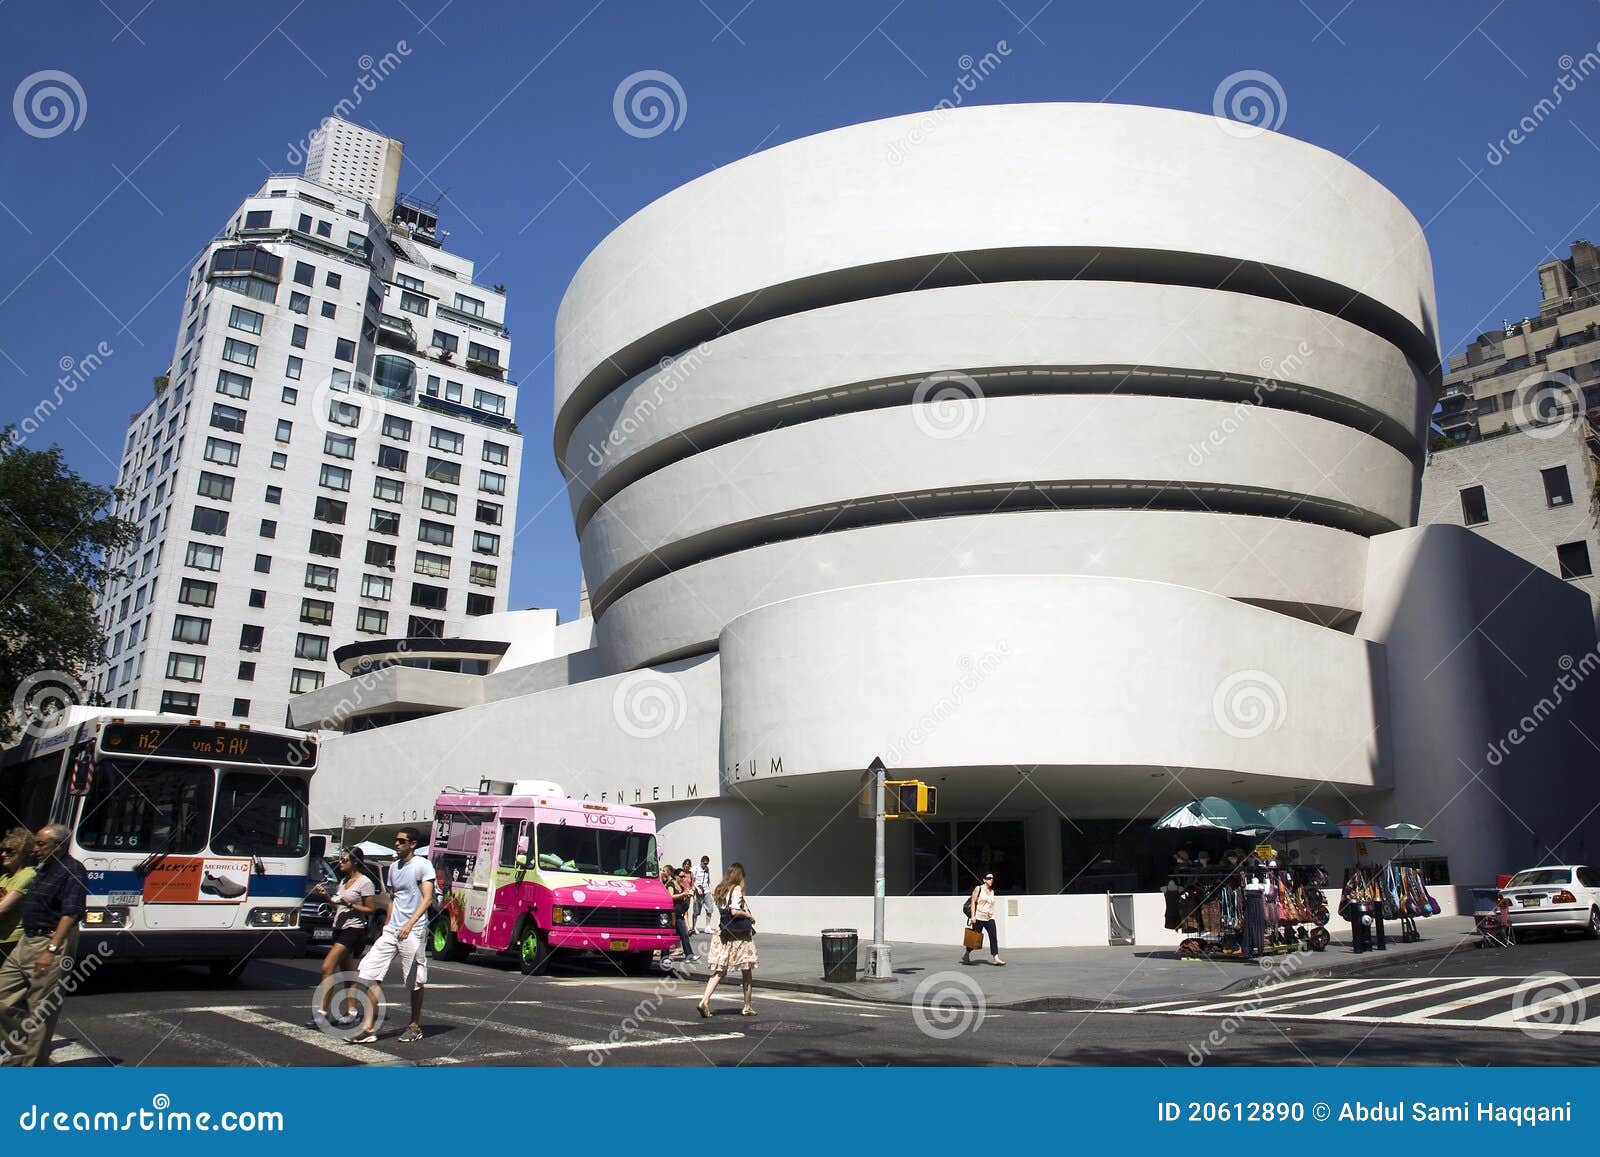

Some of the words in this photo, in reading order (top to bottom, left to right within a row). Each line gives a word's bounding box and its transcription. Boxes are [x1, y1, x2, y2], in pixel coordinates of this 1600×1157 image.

[215, 737, 225, 754] 5
[229, 737, 249, 755] AV
[362, 812, 385, 825] THE
[583, 813, 616, 827] YOGO
[102, 834, 139, 847] 136
[204, 863, 241, 872] MERRELL
